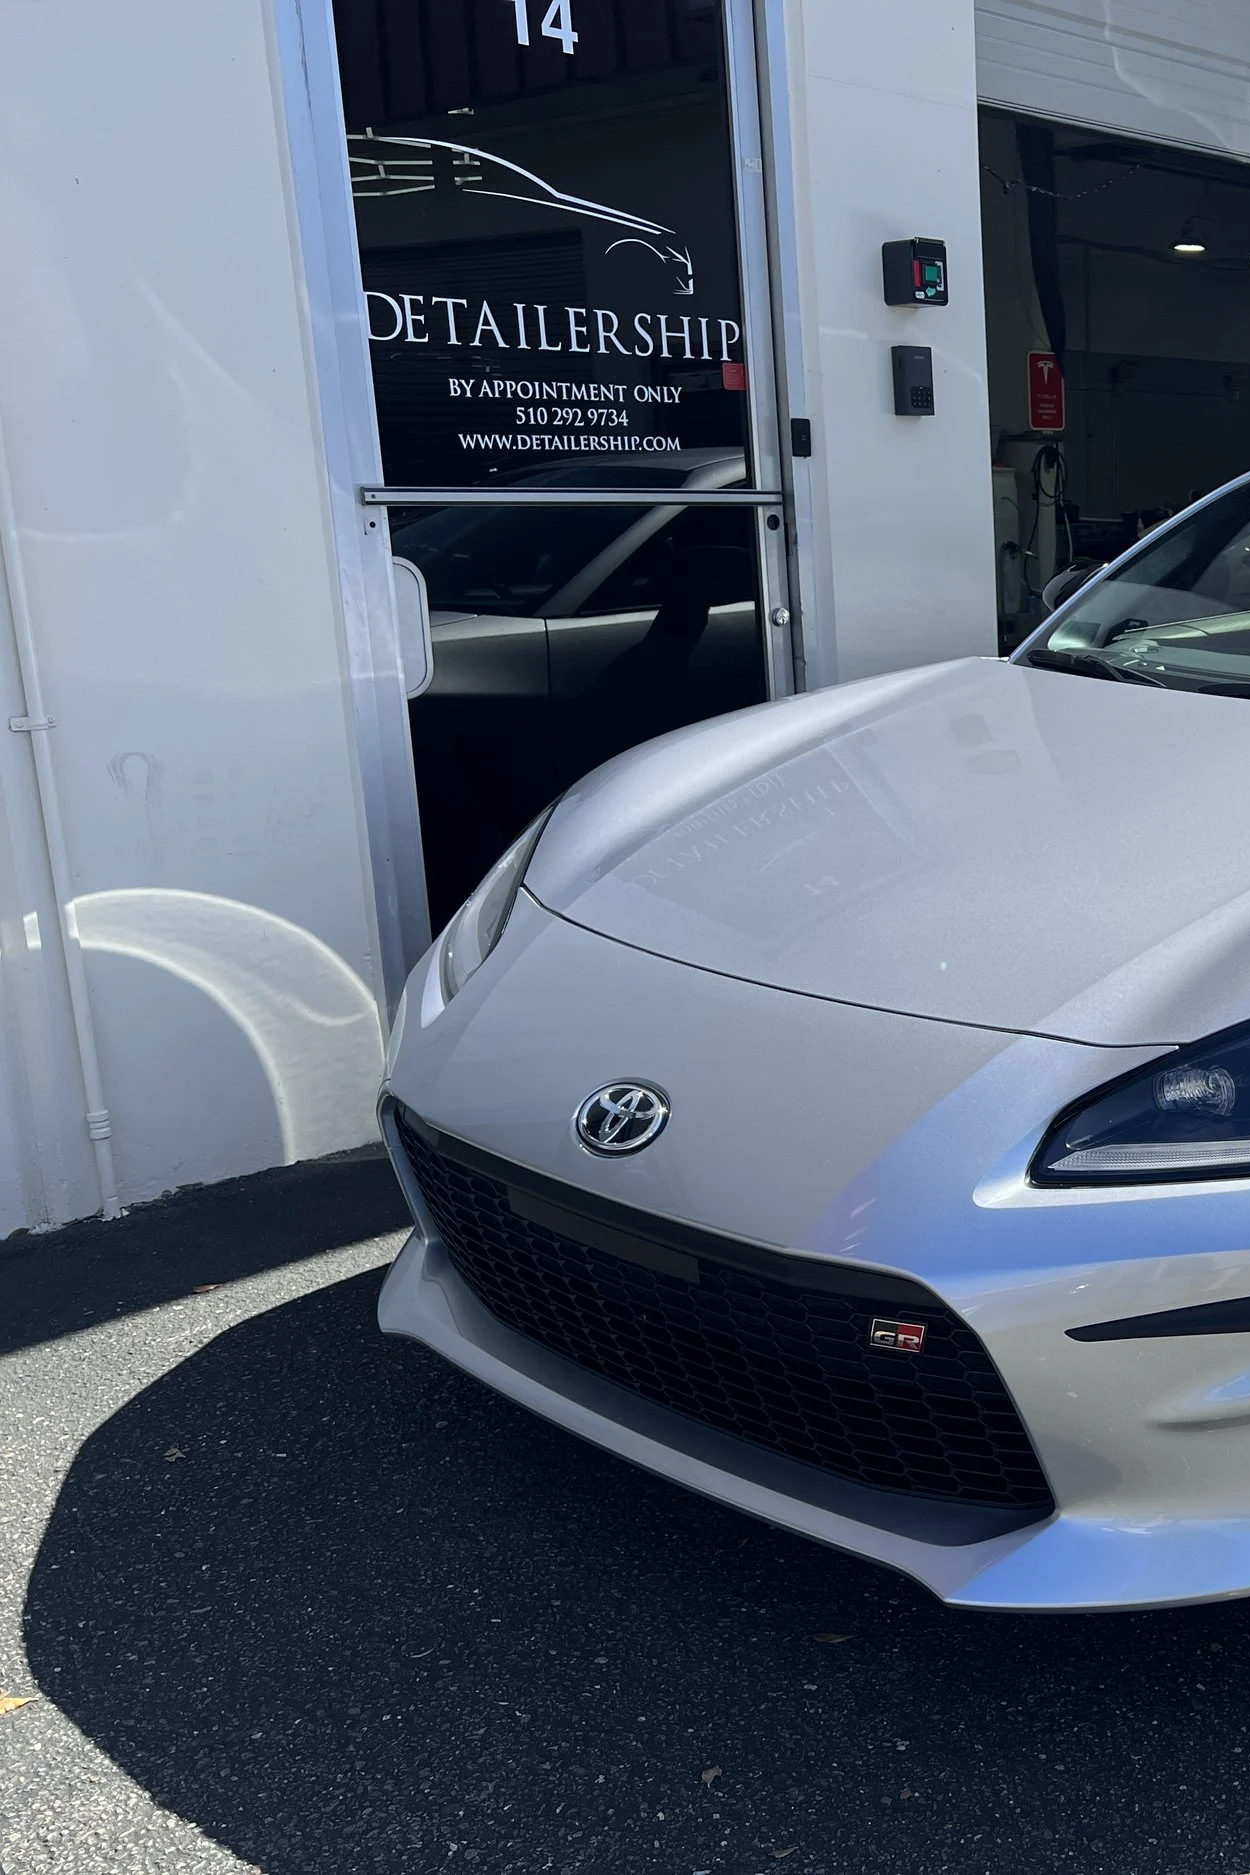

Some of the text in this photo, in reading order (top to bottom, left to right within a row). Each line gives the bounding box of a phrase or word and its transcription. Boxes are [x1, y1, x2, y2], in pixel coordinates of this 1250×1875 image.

[512, 0, 578, 54] 14
[363, 291, 740, 361] DETAILERSHIP
[449, 379, 681, 404] BY APPOINTMENT ONLY
[516, 407, 629, 427] 510 292 9734
[458, 434, 681, 451] WWW.DETAILERSHIP.COM
[873, 1330, 920, 1350] GR
